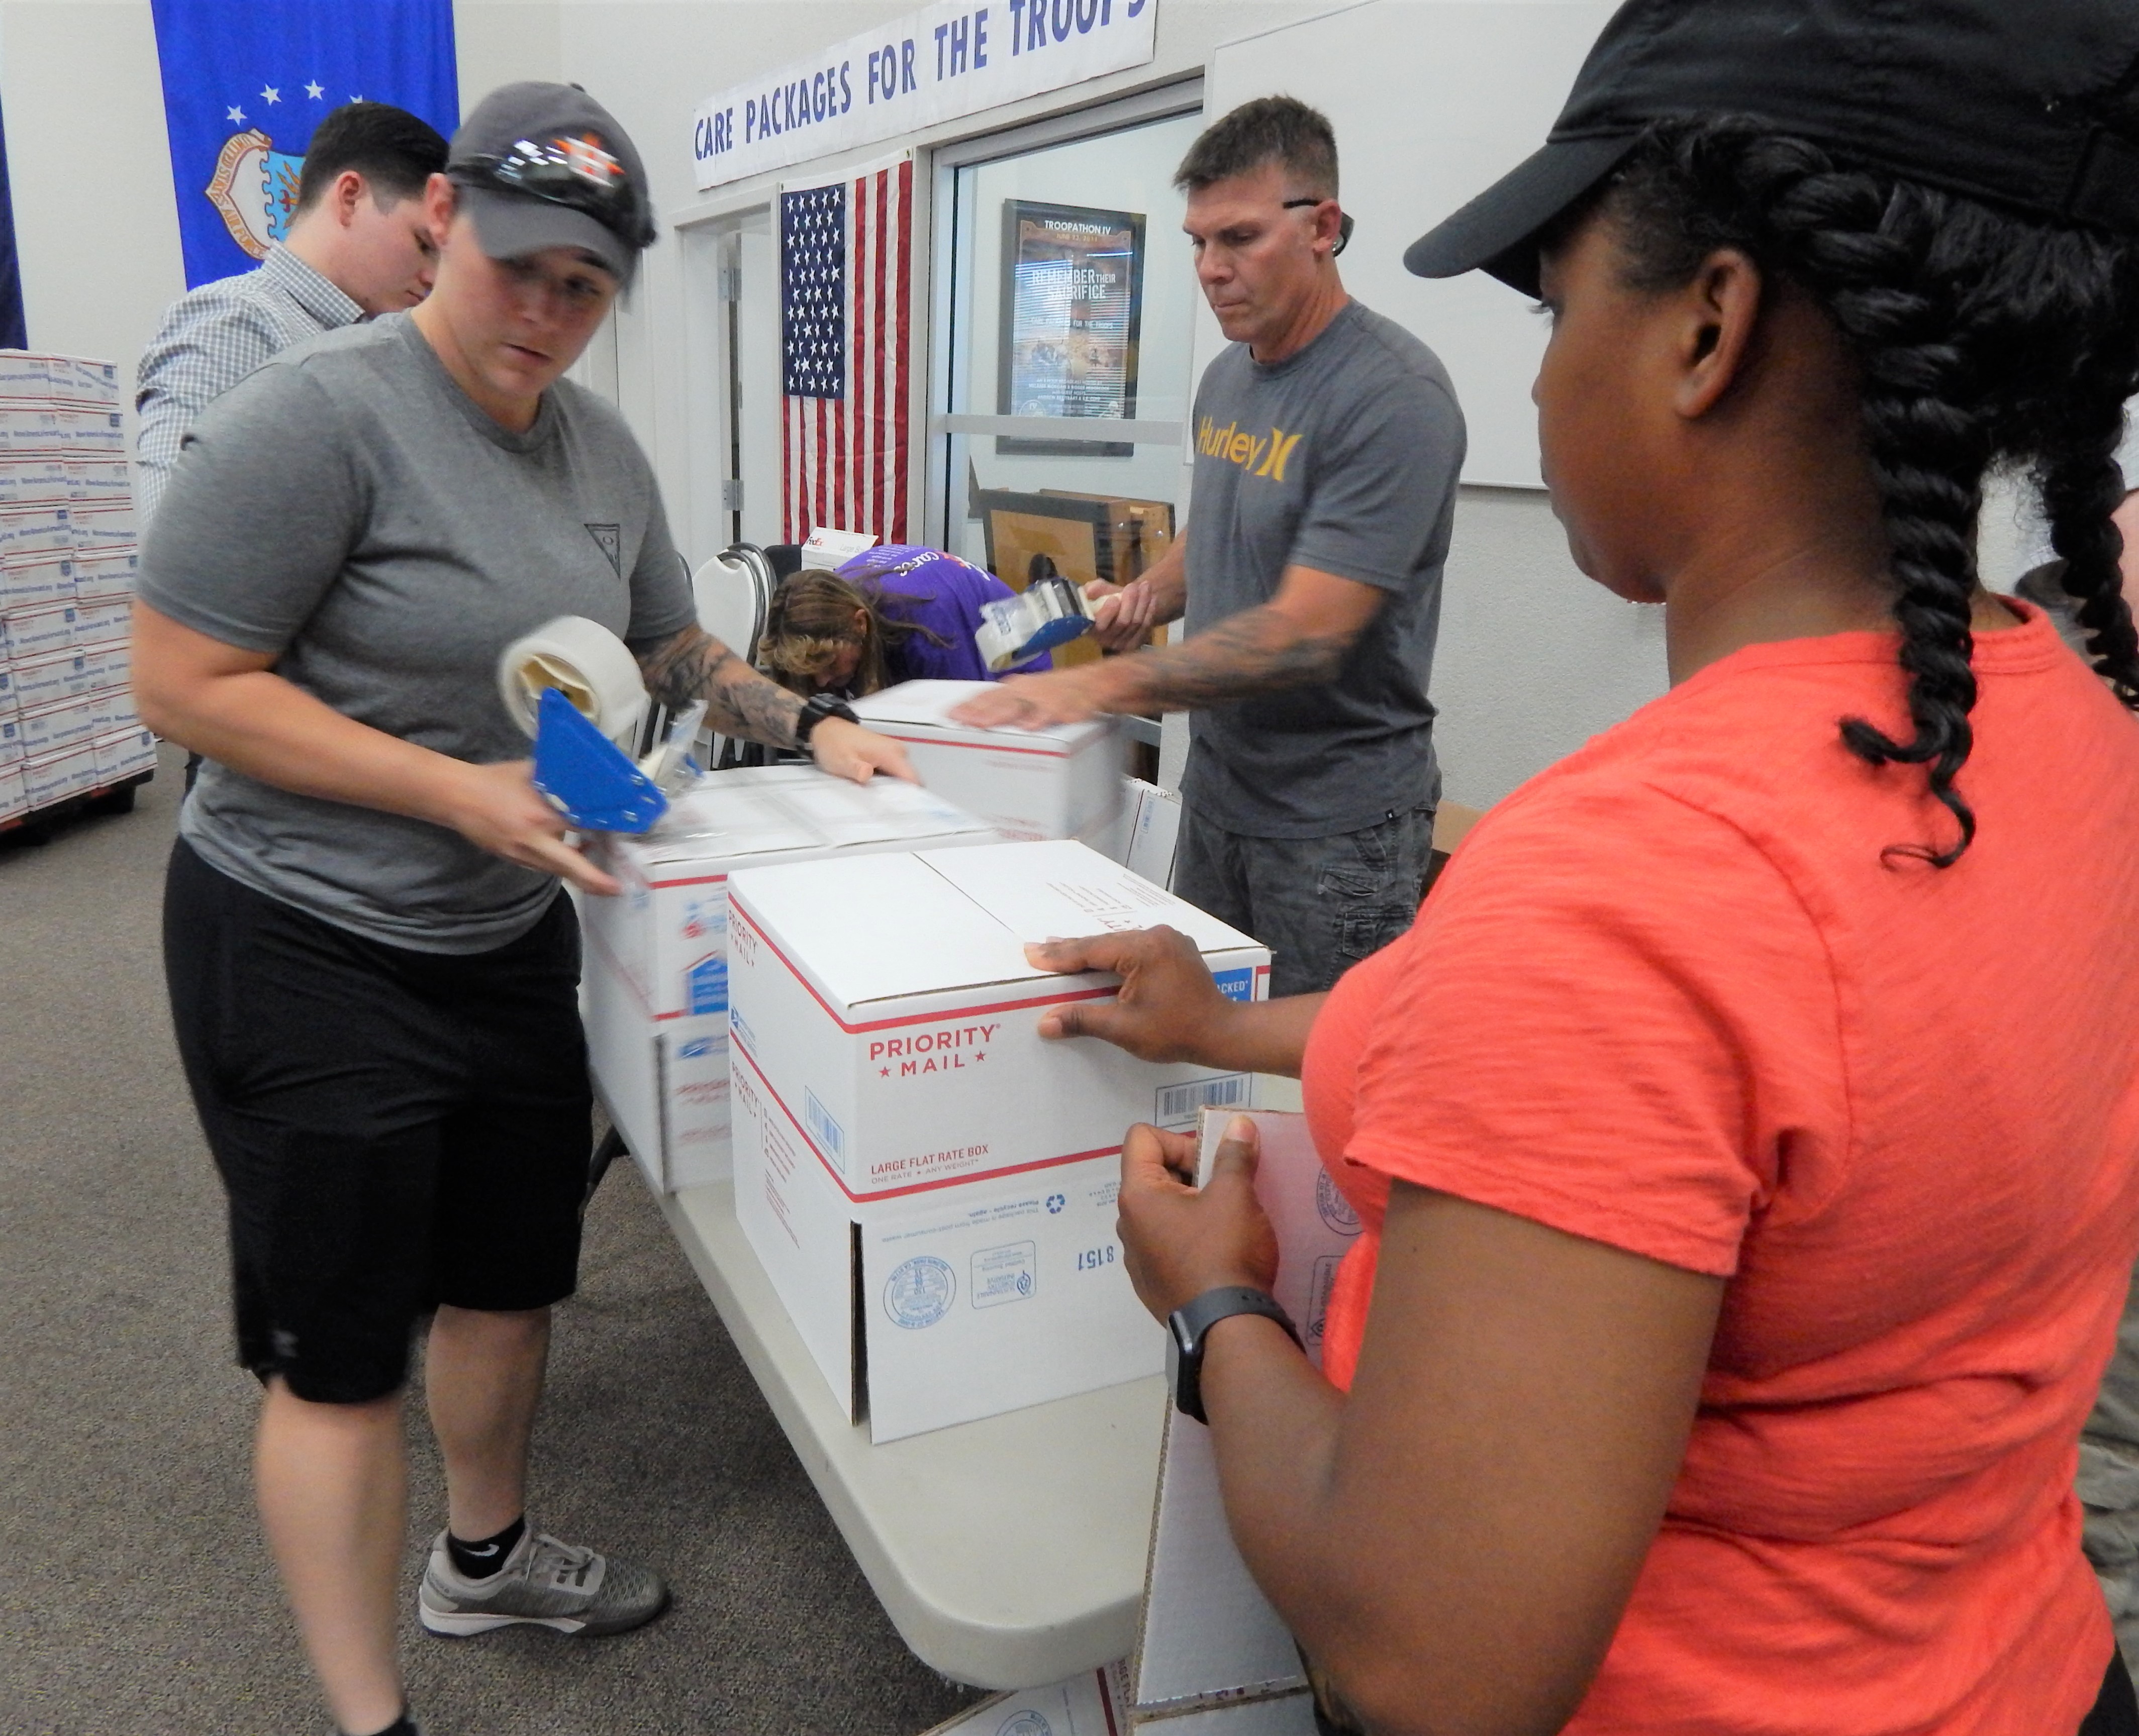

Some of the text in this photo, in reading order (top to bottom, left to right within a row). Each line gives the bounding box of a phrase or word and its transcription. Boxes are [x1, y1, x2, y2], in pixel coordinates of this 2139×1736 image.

[695, 108, 733, 160] CARE
[746, 61, 851, 144] PACKAGES
[869, 39, 917, 105] FOR
[934, 8, 988, 81] THE
[1045, 220, 1111, 235] TROOPATHON IV
[1096, 273, 1116, 283] THEIR
[1195, 416, 1267, 470] Hurley
[729, 909, 756, 954] PRIORITY
[735, 936, 749, 965] MAIL
[901, 1054, 965, 1077] MAIL
[871, 1144, 989, 1174] LARGE FLAT RATE BOX
[871, 1175, 889, 1184] ONE
[891, 1171, 912, 1180] RATE
[926, 1164, 943, 1174] ANY
[1078, 1245, 1114, 1271] 8151
[1118, 1659, 1129, 1681] RGE
